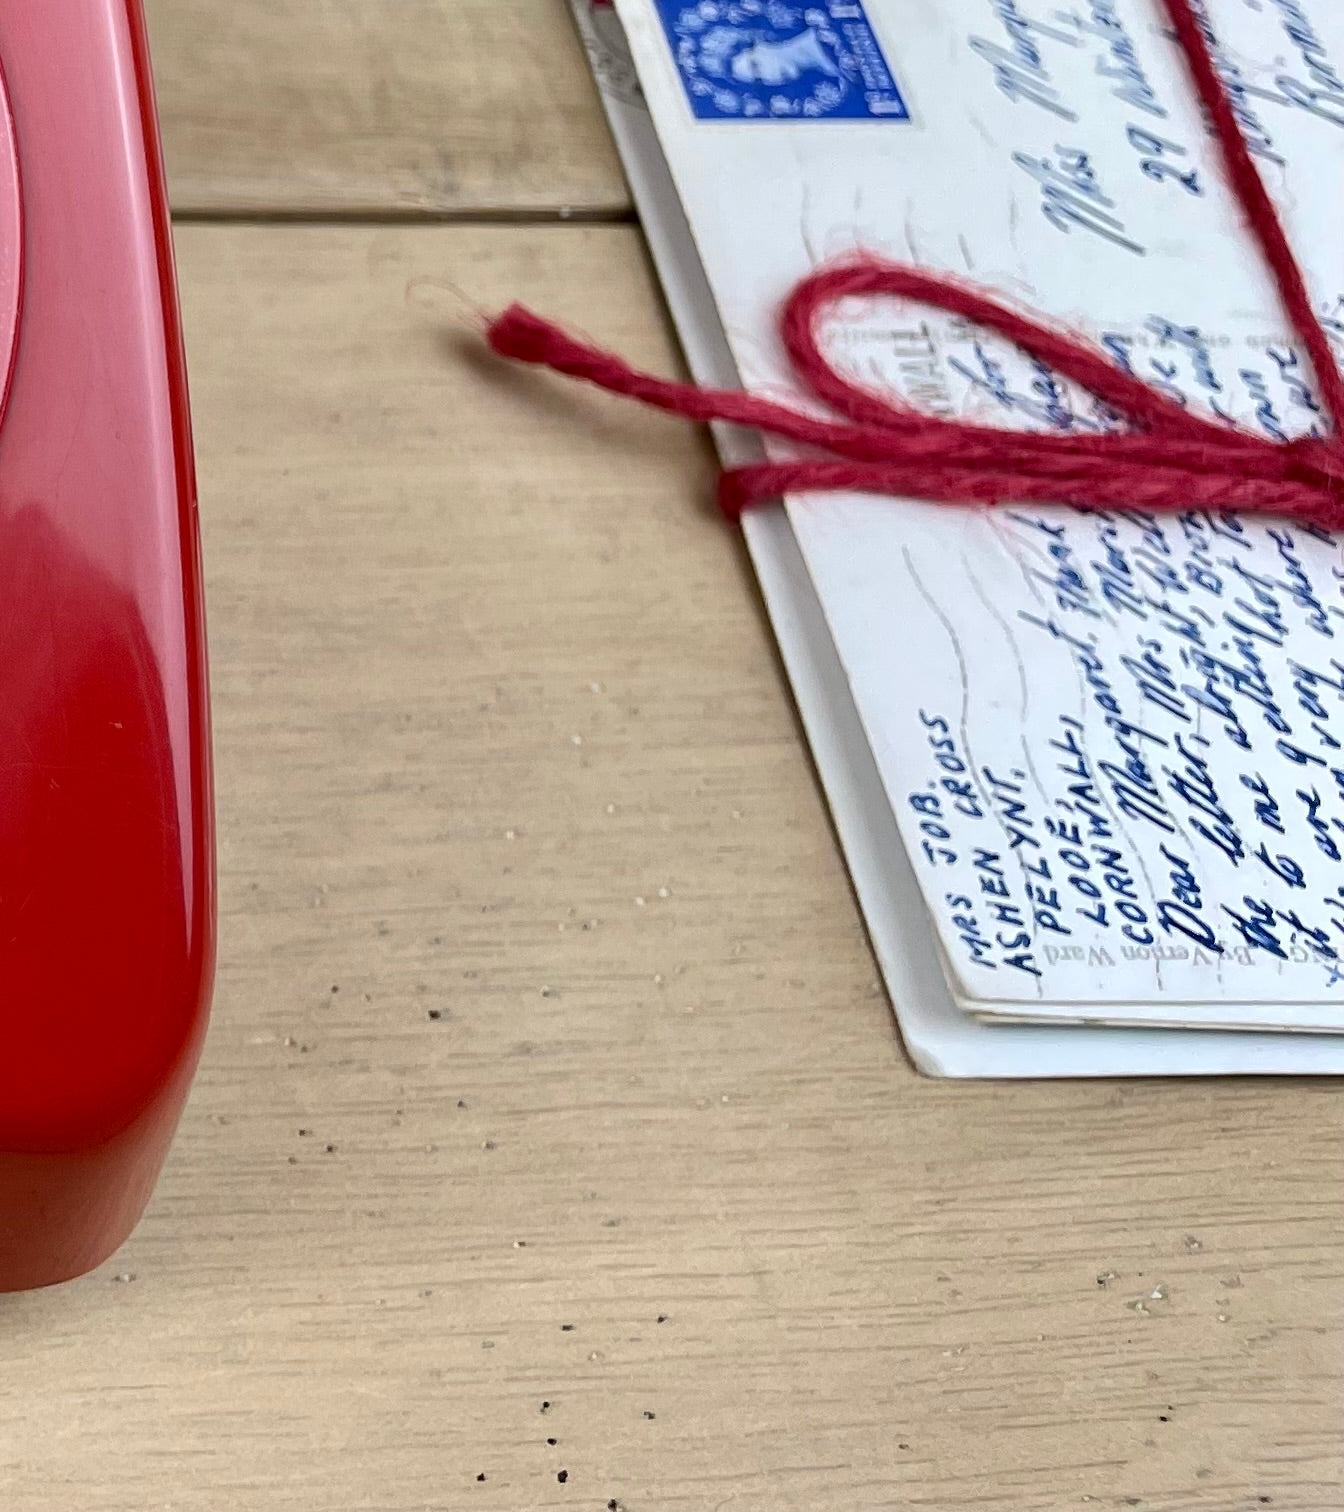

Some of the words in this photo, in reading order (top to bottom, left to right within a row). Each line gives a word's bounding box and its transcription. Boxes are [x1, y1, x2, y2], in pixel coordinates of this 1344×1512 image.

[1126, 122, 1204, 196] 29
[1011, 143, 1146, 255] Miss
[1119, 634, 1190, 722] Mrs
[918, 708, 983, 817] CROSS
[1162, 731, 1244, 867] letter,
[907, 780, 957, 865] JOB.
[1048, 714, 1153, 944] CORNWALL,
[1239, 770, 1285, 834] me
[1296, 783, 1341, 860] are
[1157, 842, 1223, 952] Dear
[1253, 841, 1305, 888] to
[945, 891, 997, 969] MRS
[973, 847, 1042, 976] ASHEN
[1220, 895, 1288, 959] the
[1275, 908, 1337, 957] it
[1042, 943, 1115, 967] Ward
[1121, 943, 1212, 968] Vernon
